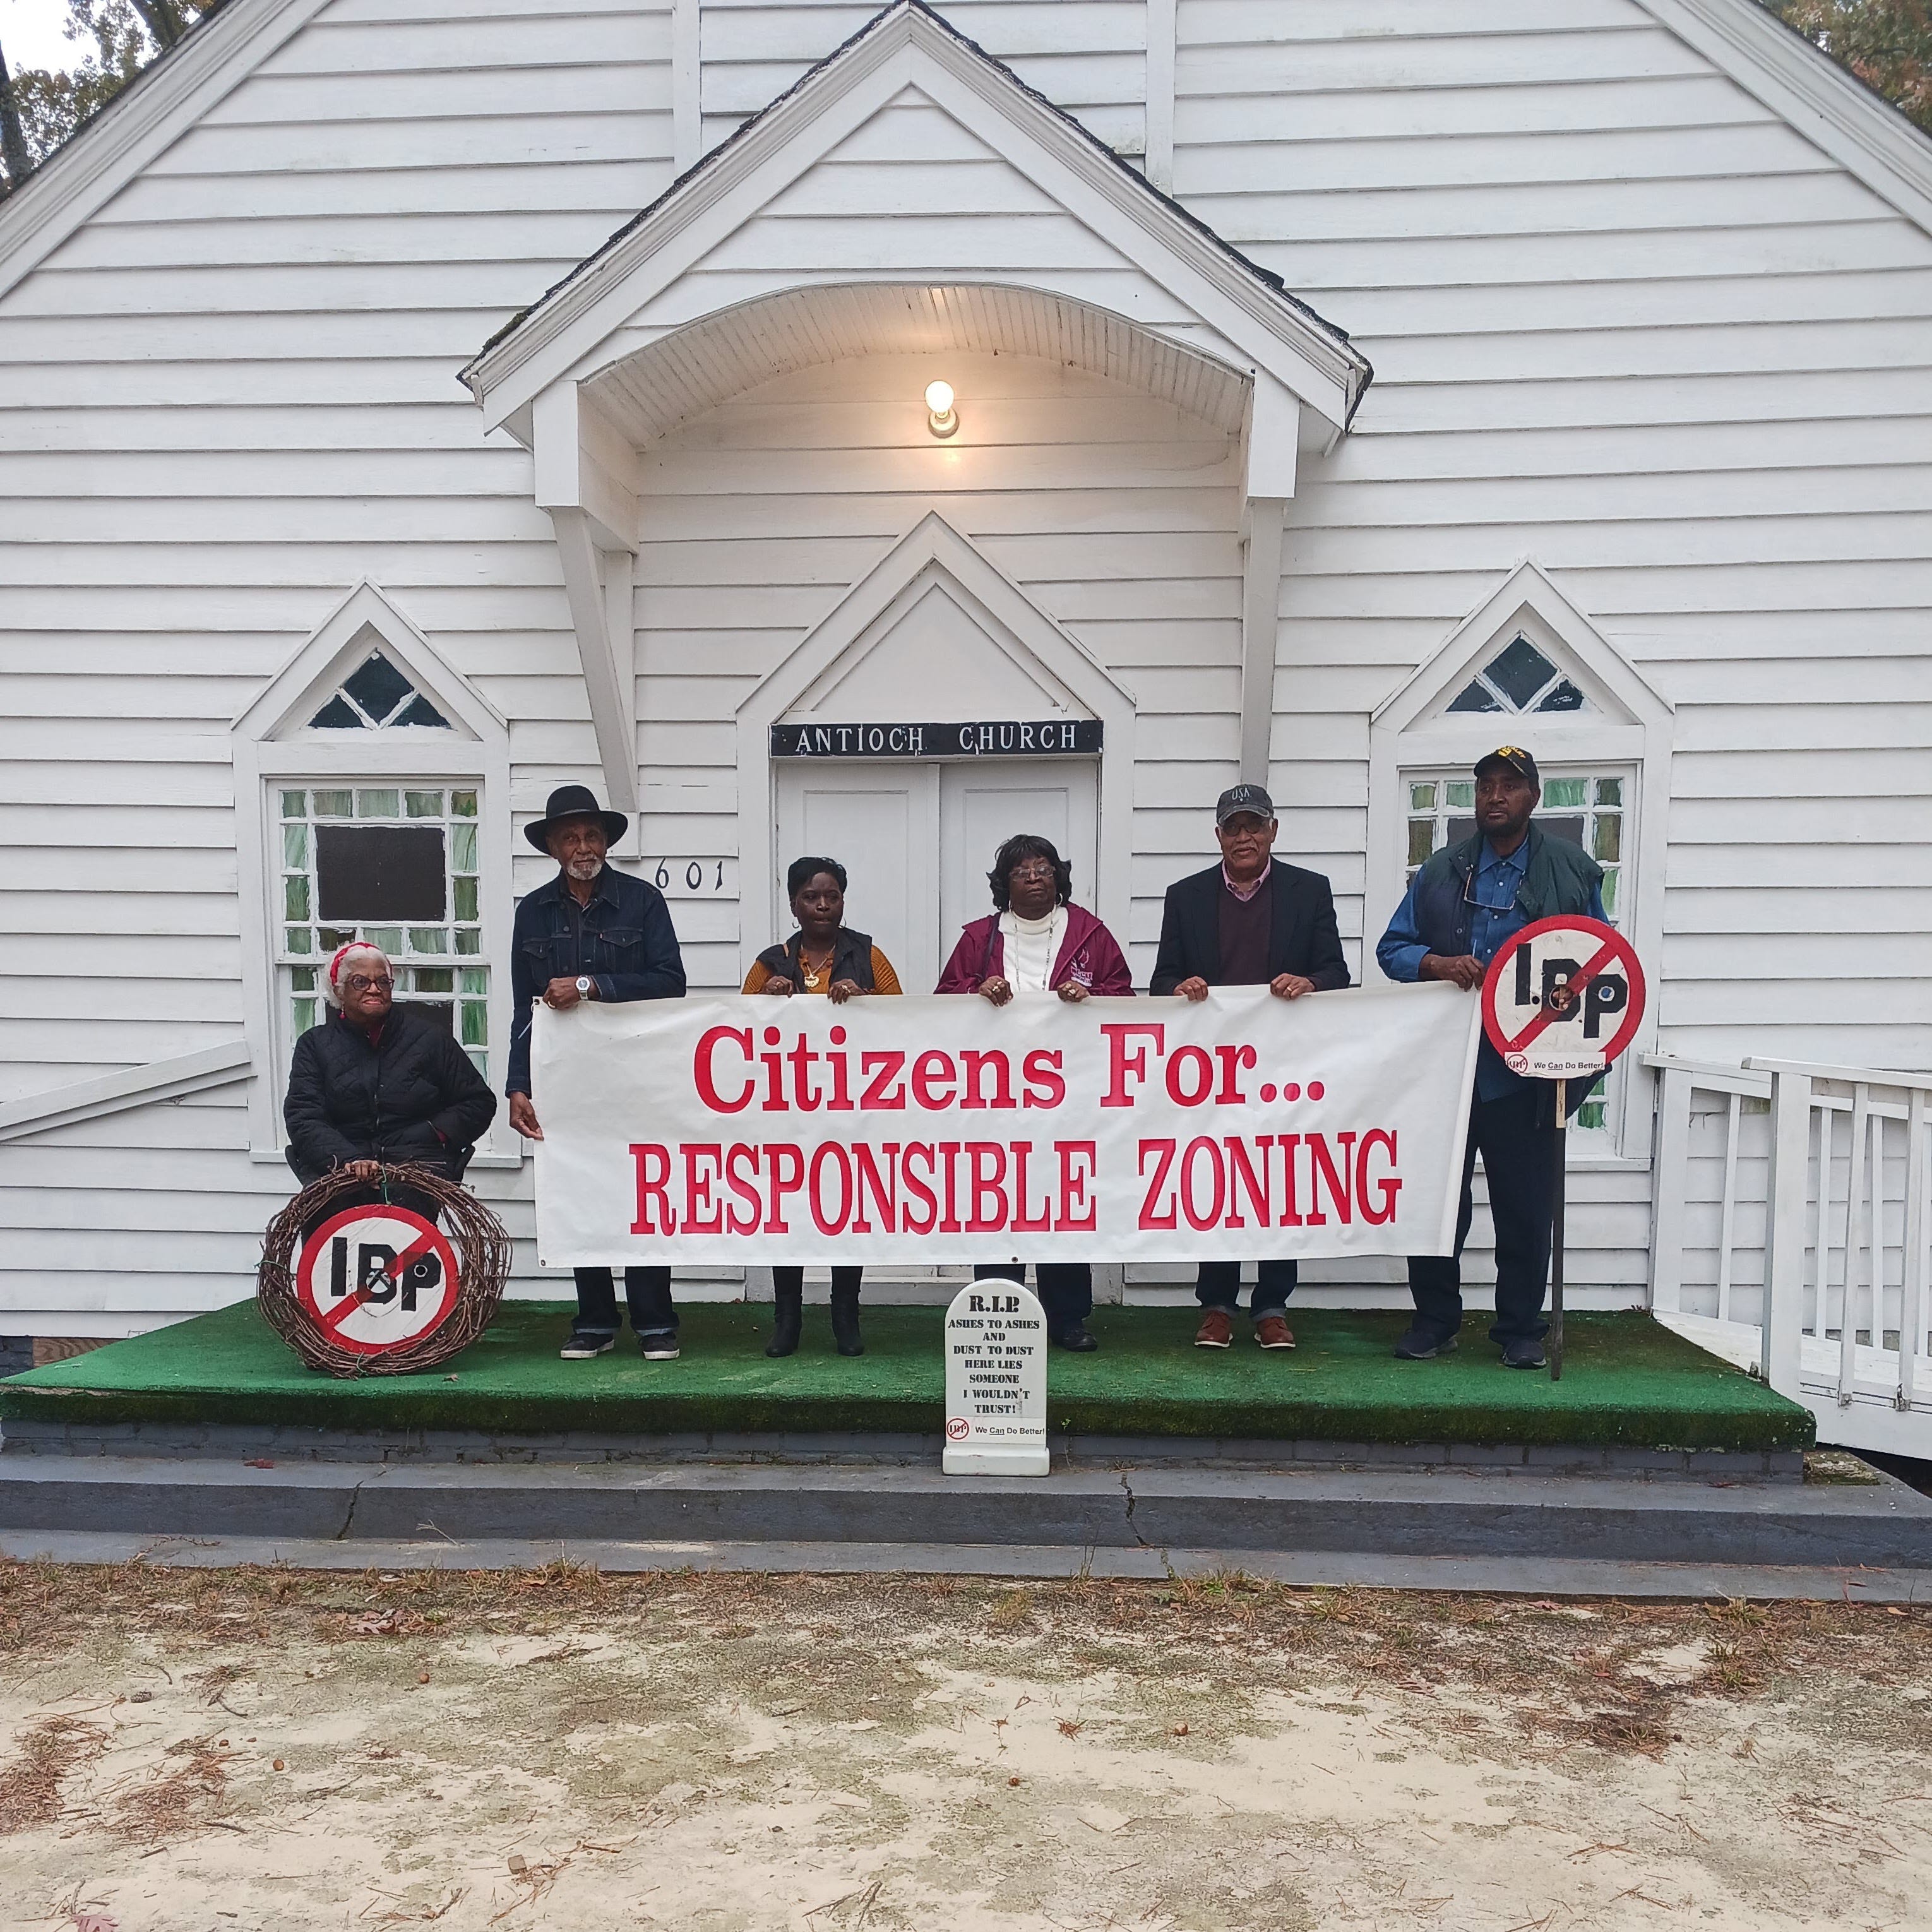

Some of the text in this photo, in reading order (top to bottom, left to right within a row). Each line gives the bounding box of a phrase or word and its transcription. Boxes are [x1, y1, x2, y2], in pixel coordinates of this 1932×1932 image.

[795, 724, 1076, 753] ANTIOCH CHURCH
[1232, 786, 1250, 801] USA
[655, 857, 724, 891] 601
[694, 1023, 1325, 1114] Citizens For...
[629, 1128, 1402, 1236] RESPONSIBLE ZONING
[948, 1319, 1040, 1330] ASHES TO ASHES
[982, 1332, 1006, 1342] AND
[953, 1345, 1034, 1356] DUST TO DUST
[965, 1359, 1023, 1369] HERE LIES
[969, 1374, 1020, 1384] SOMEONE
[963, 1388, 1030, 1400] I WOULDN'T
[974, 1404, 1016, 1414] TRUST!
[989, 1427, 1005, 1435] Can
